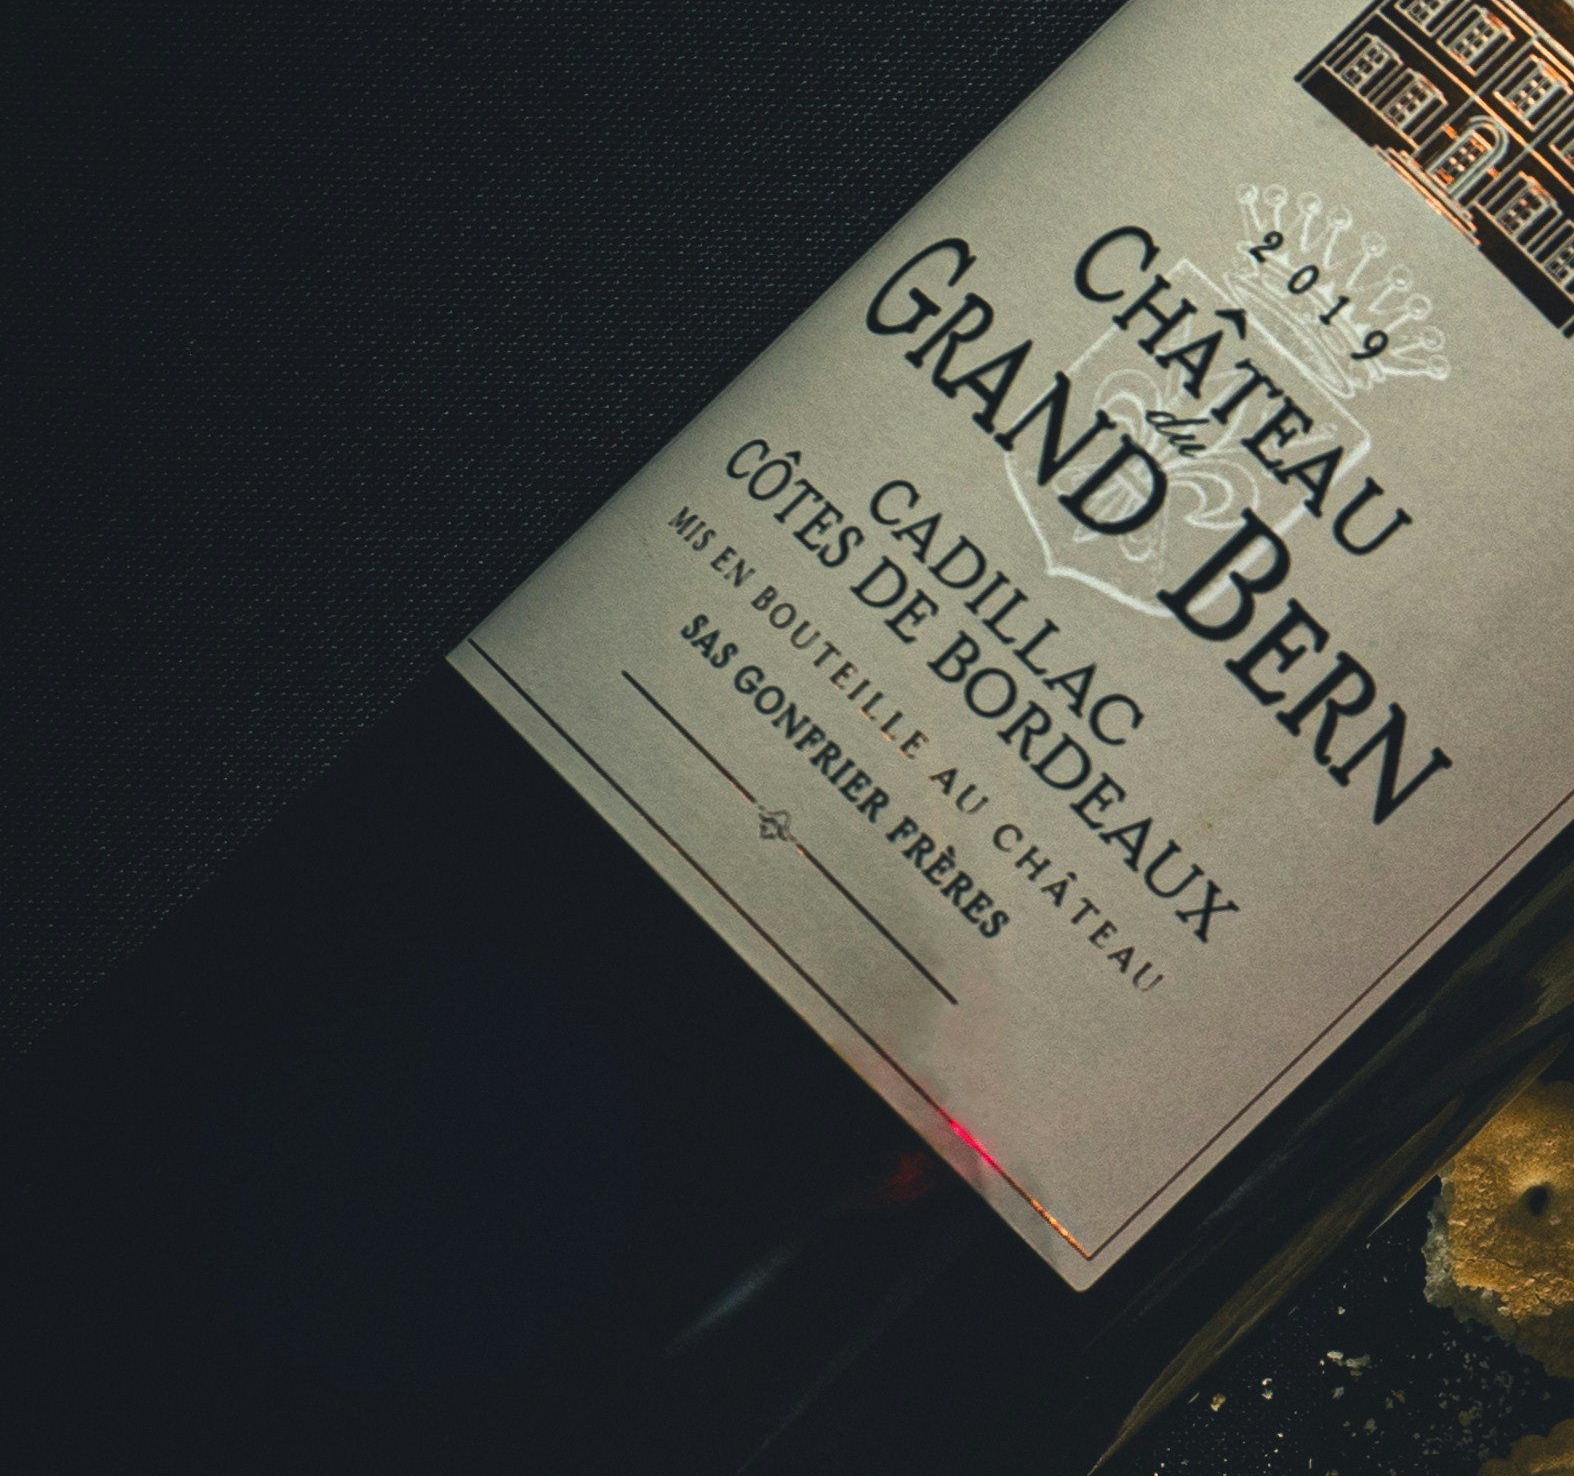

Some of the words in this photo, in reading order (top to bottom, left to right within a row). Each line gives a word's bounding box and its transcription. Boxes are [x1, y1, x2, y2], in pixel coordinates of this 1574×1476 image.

[1073, 225, 1414, 557] CHÂTEAU
[1145, 409, 1209, 458] du
[1248, 230, 1390, 362] 2019
[725, 438, 866, 569] CÔTES
[849, 555, 940, 645] DE
[926, 629, 1240, 944] BORDEAUX
[865, 237, 1169, 537] GRAND
[1155, 506, 1454, 826] BERN
[869, 479, 1145, 747] CADILLAC
[669, 505, 716, 551] MIS
[710, 546, 756, 588] EN
[750, 585, 928, 758] BOUTEILLE
[929, 767, 989, 817] AU
[992, 823, 1164, 988] CHÂTEAU
[680, 613, 739, 669] SAS
[733, 664, 890, 824] GONFRIER
[885, 815, 1010, 939] FRÈRES
